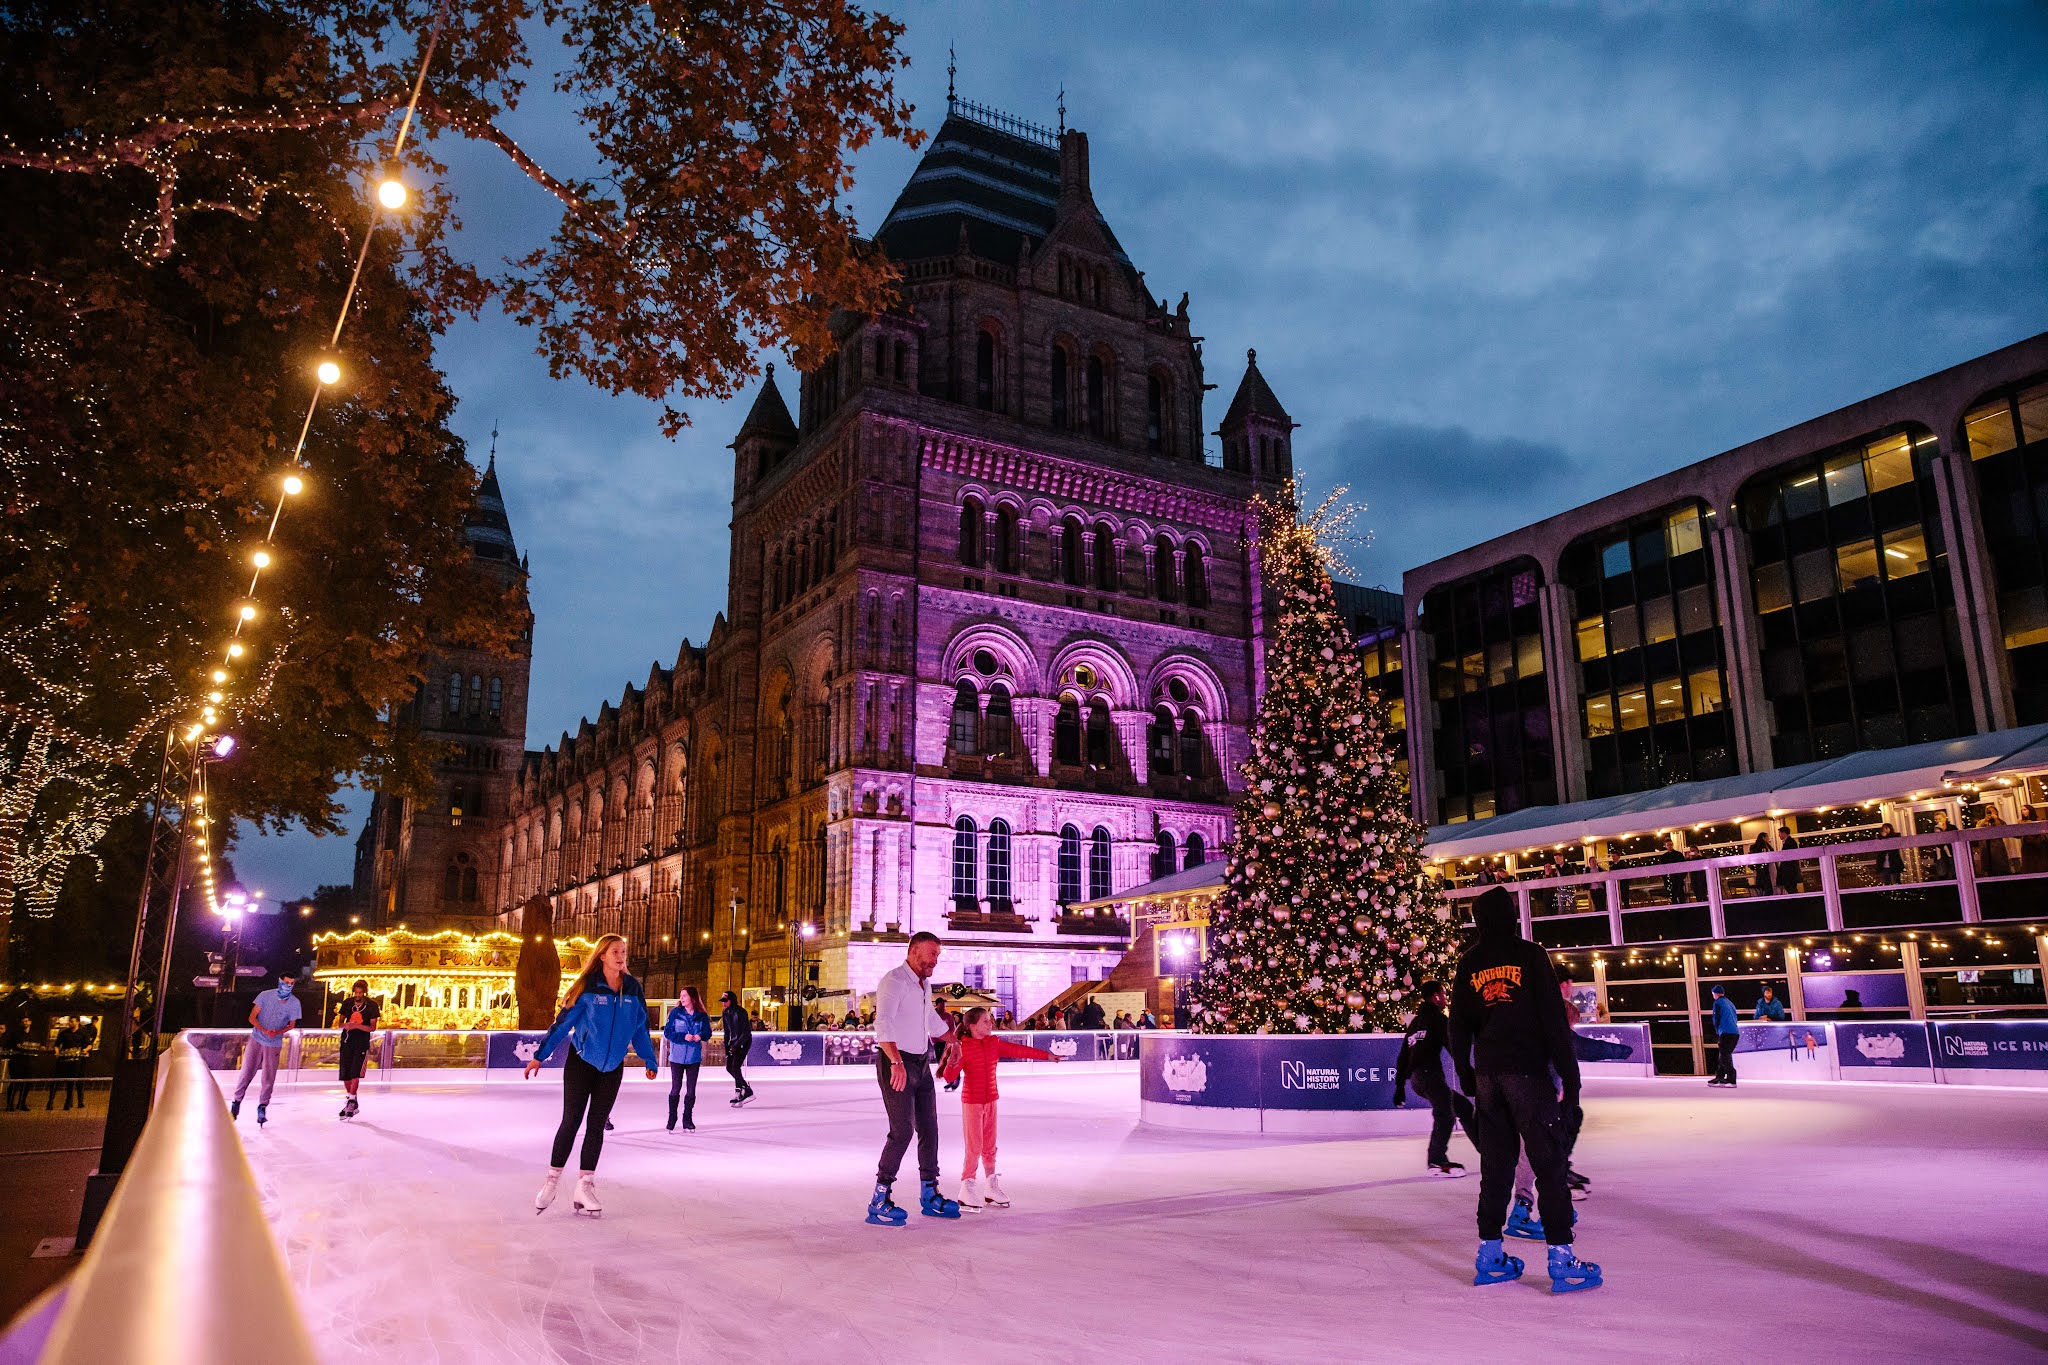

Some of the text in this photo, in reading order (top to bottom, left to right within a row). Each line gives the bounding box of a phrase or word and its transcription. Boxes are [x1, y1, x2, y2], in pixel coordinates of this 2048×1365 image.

[1992, 1041, 2048, 1051] ICE RIN
[1306, 1068, 1340, 1076] NATURAL
[1348, 1067, 1380, 1082] ICE
[1306, 1075, 1340, 1083] HISTORY
[1306, 1082, 1340, 1090] MUSEUM
